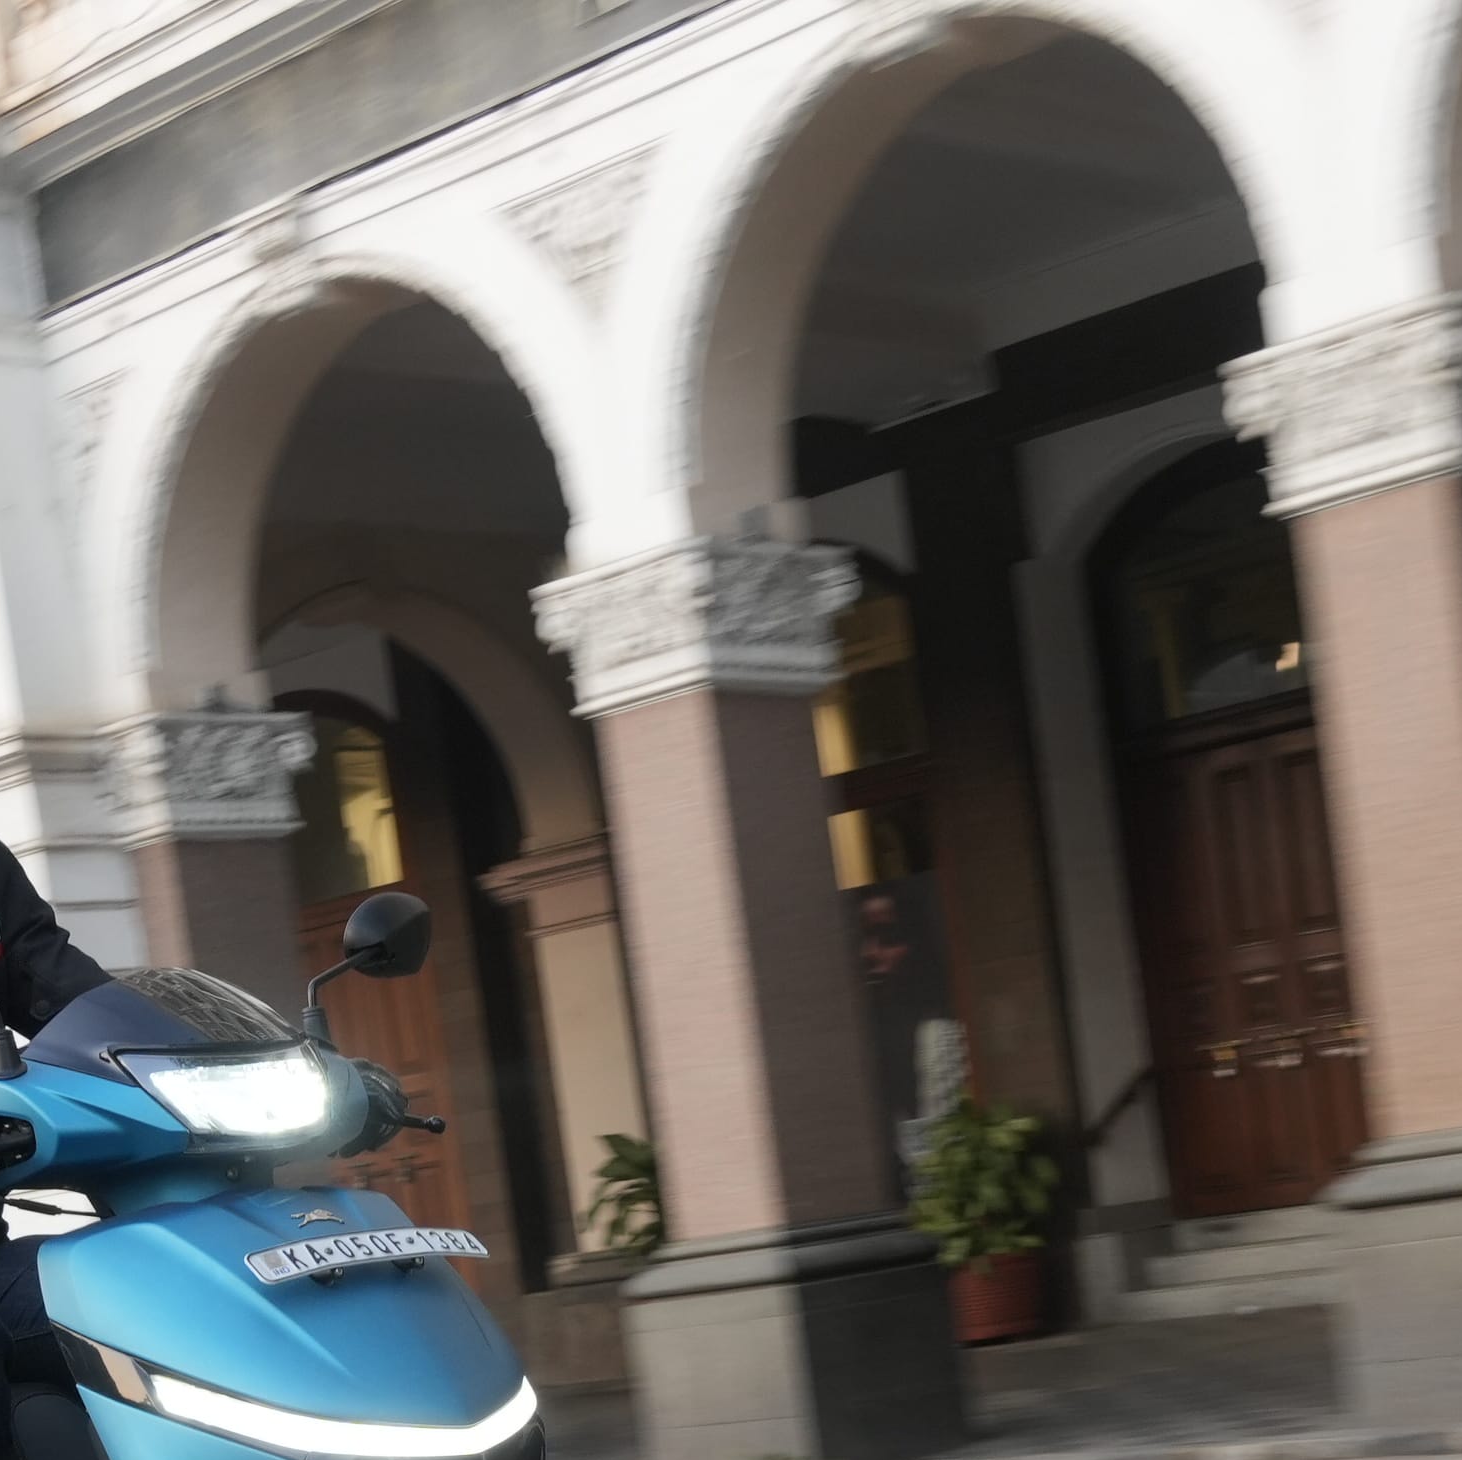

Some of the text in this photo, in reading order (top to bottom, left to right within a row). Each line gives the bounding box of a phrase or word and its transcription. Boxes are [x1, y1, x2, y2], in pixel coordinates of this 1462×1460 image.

[282, 1230, 482, 1270] KA 05QF 1384
